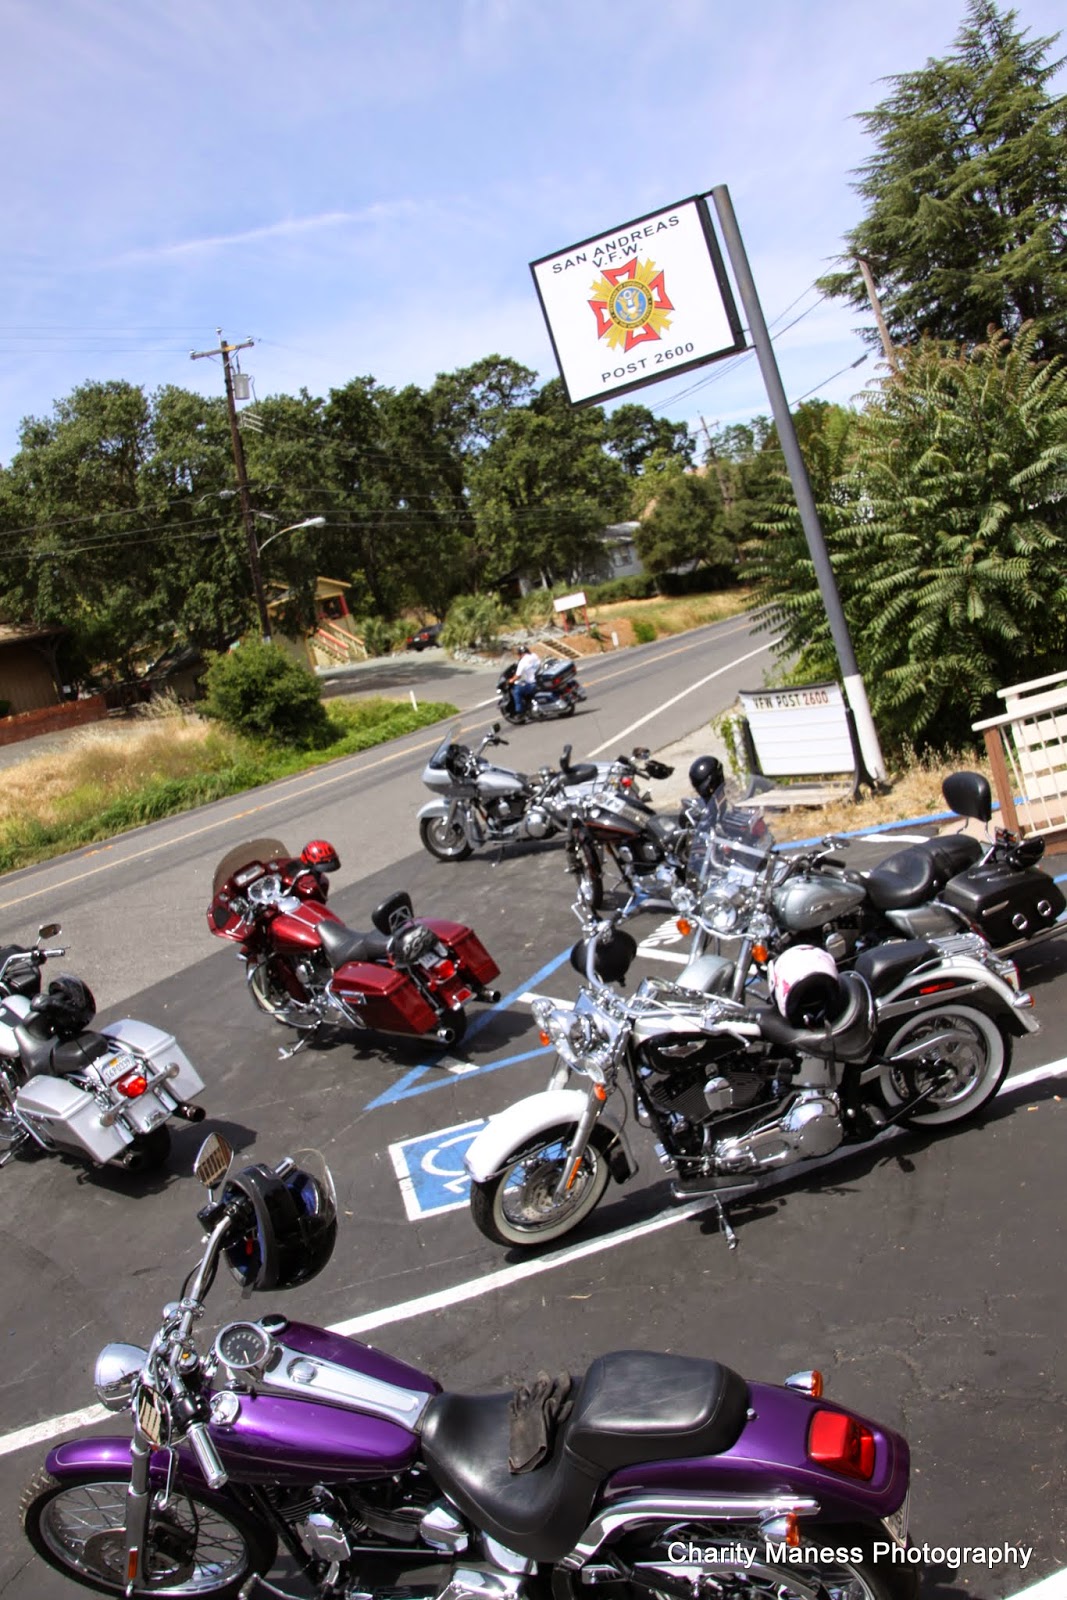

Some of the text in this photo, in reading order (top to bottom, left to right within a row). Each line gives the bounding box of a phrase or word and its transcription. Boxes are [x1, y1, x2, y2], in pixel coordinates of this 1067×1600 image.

[552, 216, 680, 274] SAN ANDREAS
[592, 243, 643, 268] V.F.W.
[601, 342, 694, 383] POST 2600
[776, 693, 800, 708] POST
[802, 691, 829, 706] 2600
